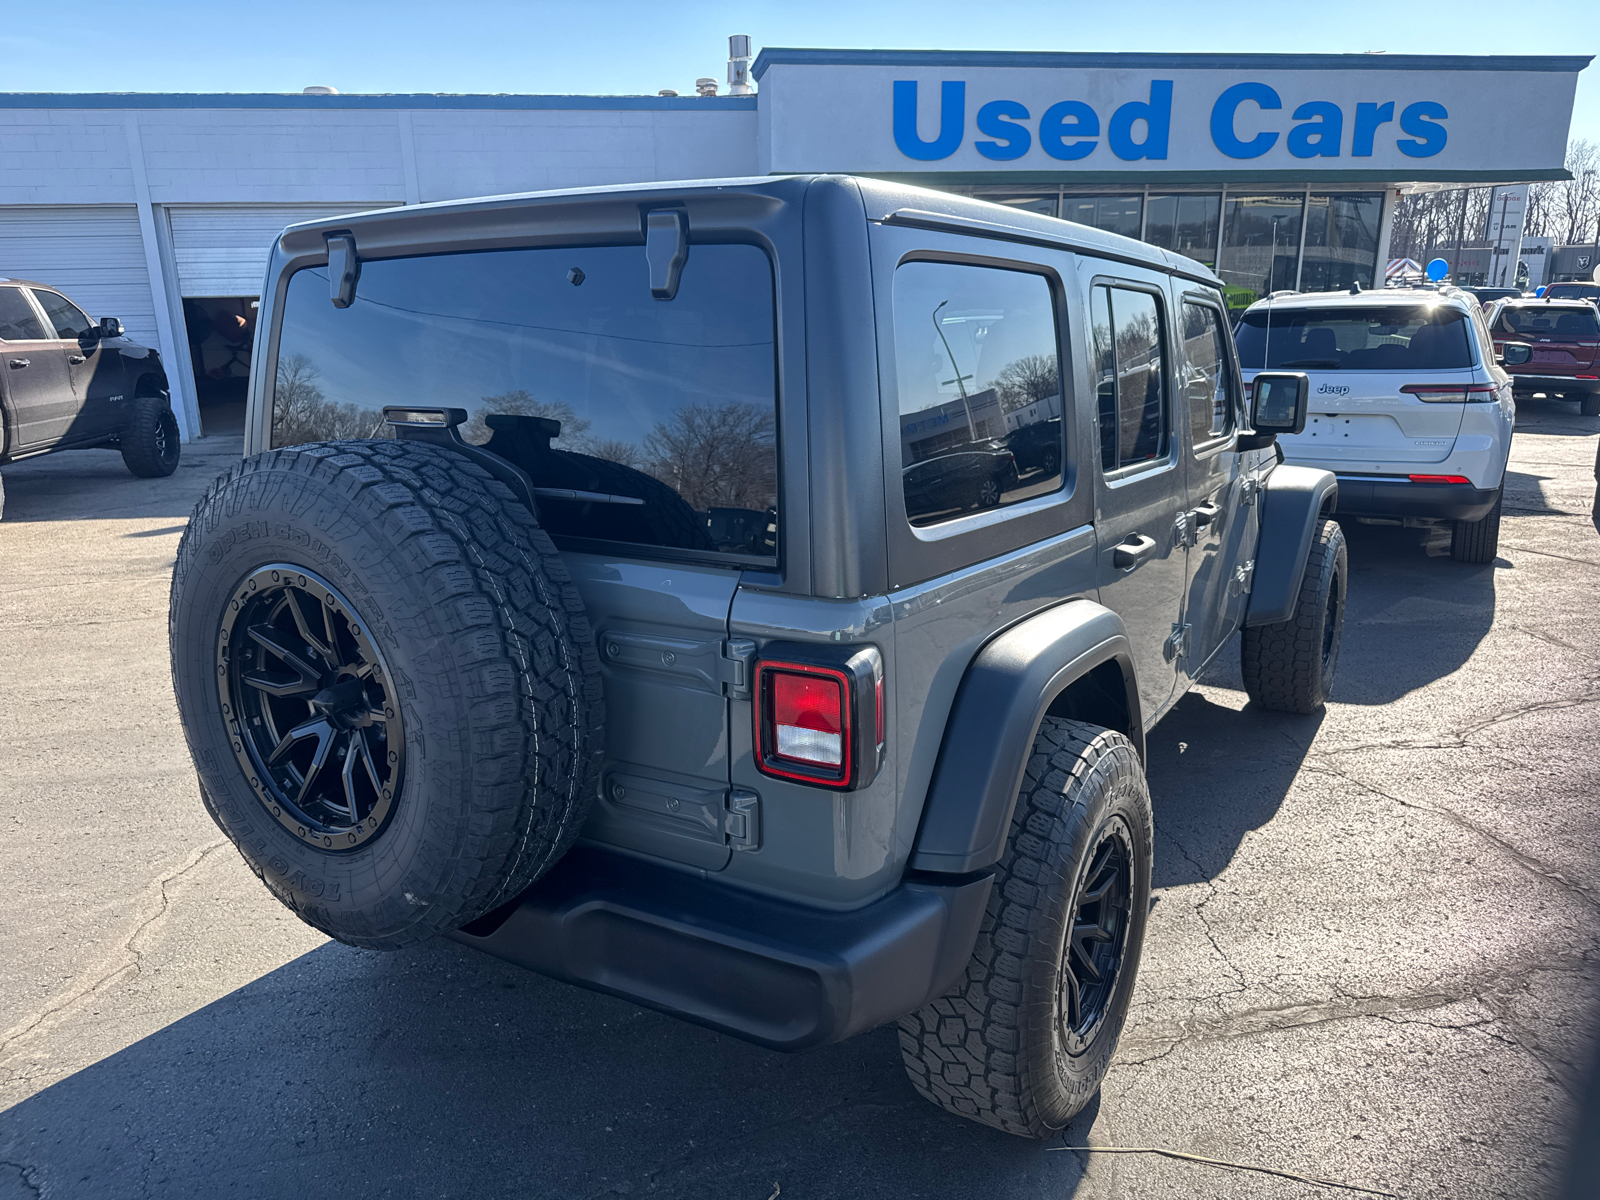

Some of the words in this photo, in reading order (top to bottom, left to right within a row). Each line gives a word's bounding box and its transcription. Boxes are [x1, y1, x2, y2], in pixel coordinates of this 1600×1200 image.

[893, 80, 1173, 161] Used
[1210, 82, 1448, 159] Cars
[1317, 383, 1349, 396] Jeep
[207, 520, 269, 565] OPEN
[275, 521, 400, 649] COUNTRY
[198, 748, 267, 858] TIRES
[265, 852, 341, 903] TOYO
